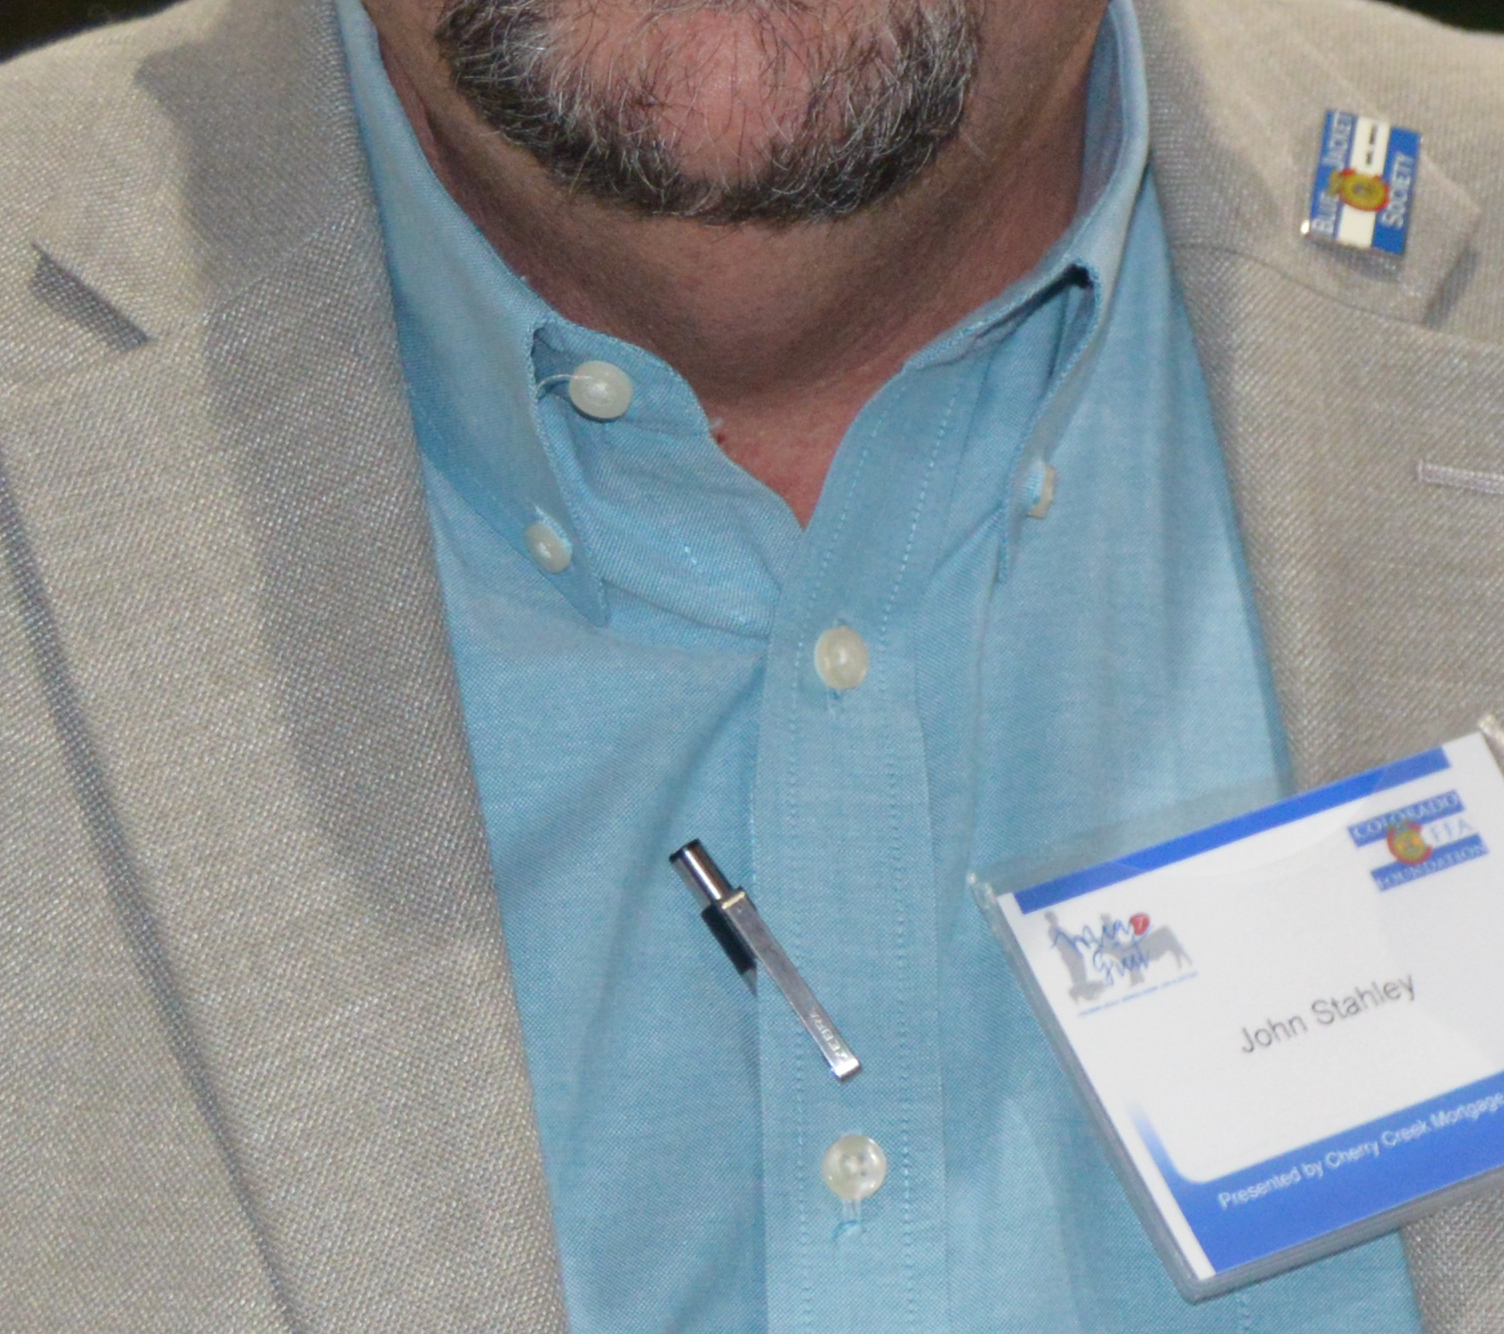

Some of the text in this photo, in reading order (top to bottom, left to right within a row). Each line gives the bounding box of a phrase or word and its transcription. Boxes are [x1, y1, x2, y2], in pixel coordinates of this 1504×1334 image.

[1353, 789, 1460, 837] COLORADO
[1241, 973, 1416, 1054] John Stahley
[1218, 1166, 1301, 1210] Presented
[1301, 1157, 1325, 1181] by
[1325, 1141, 1381, 1169] Cherry
[1381, 1120, 1432, 1147] Creek
